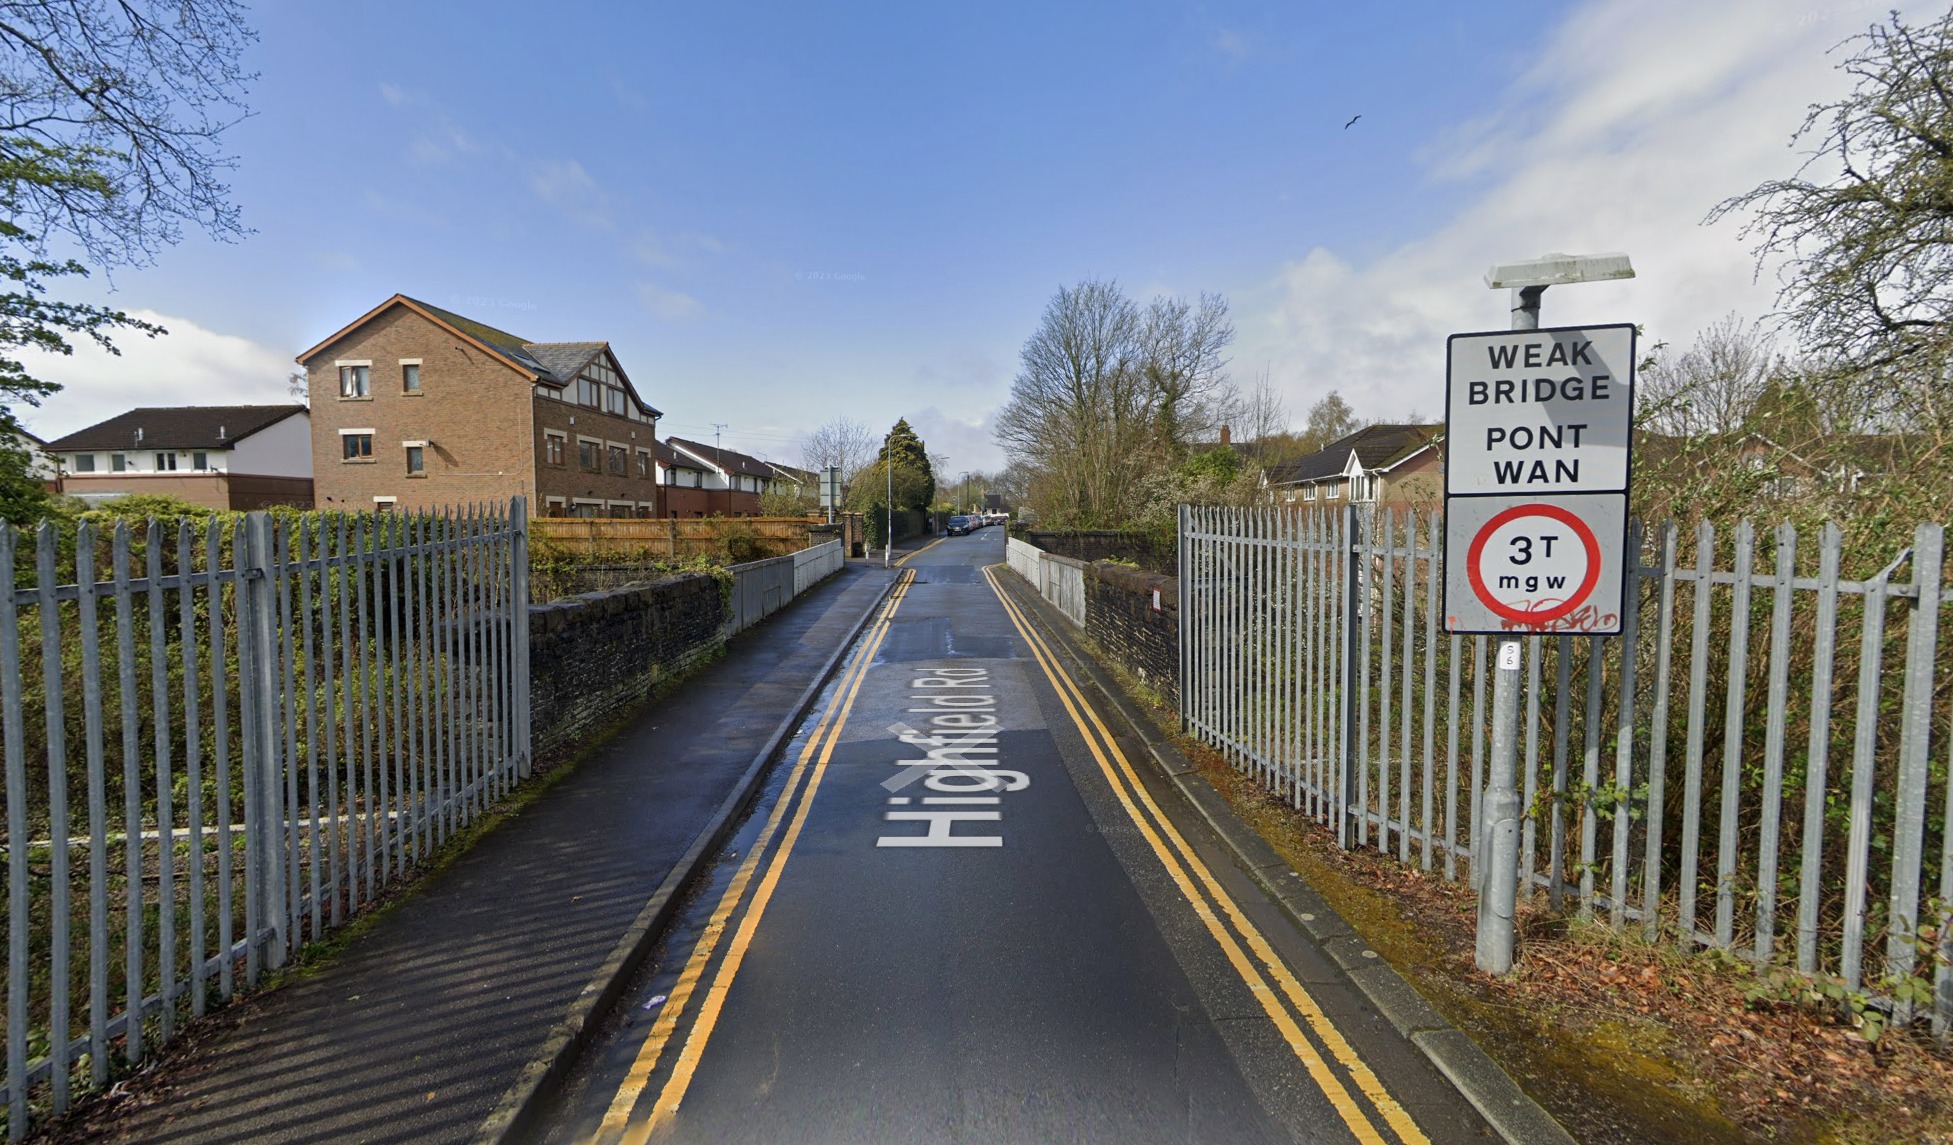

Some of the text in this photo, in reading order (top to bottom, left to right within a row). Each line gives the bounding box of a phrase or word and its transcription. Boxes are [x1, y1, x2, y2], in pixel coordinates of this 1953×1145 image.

[1488, 340, 1593, 370] WEAK
[1468, 375, 1610, 405] BRIDGE
[1486, 424, 1588, 451] PONT
[1493, 459, 1579, 485] WAN
